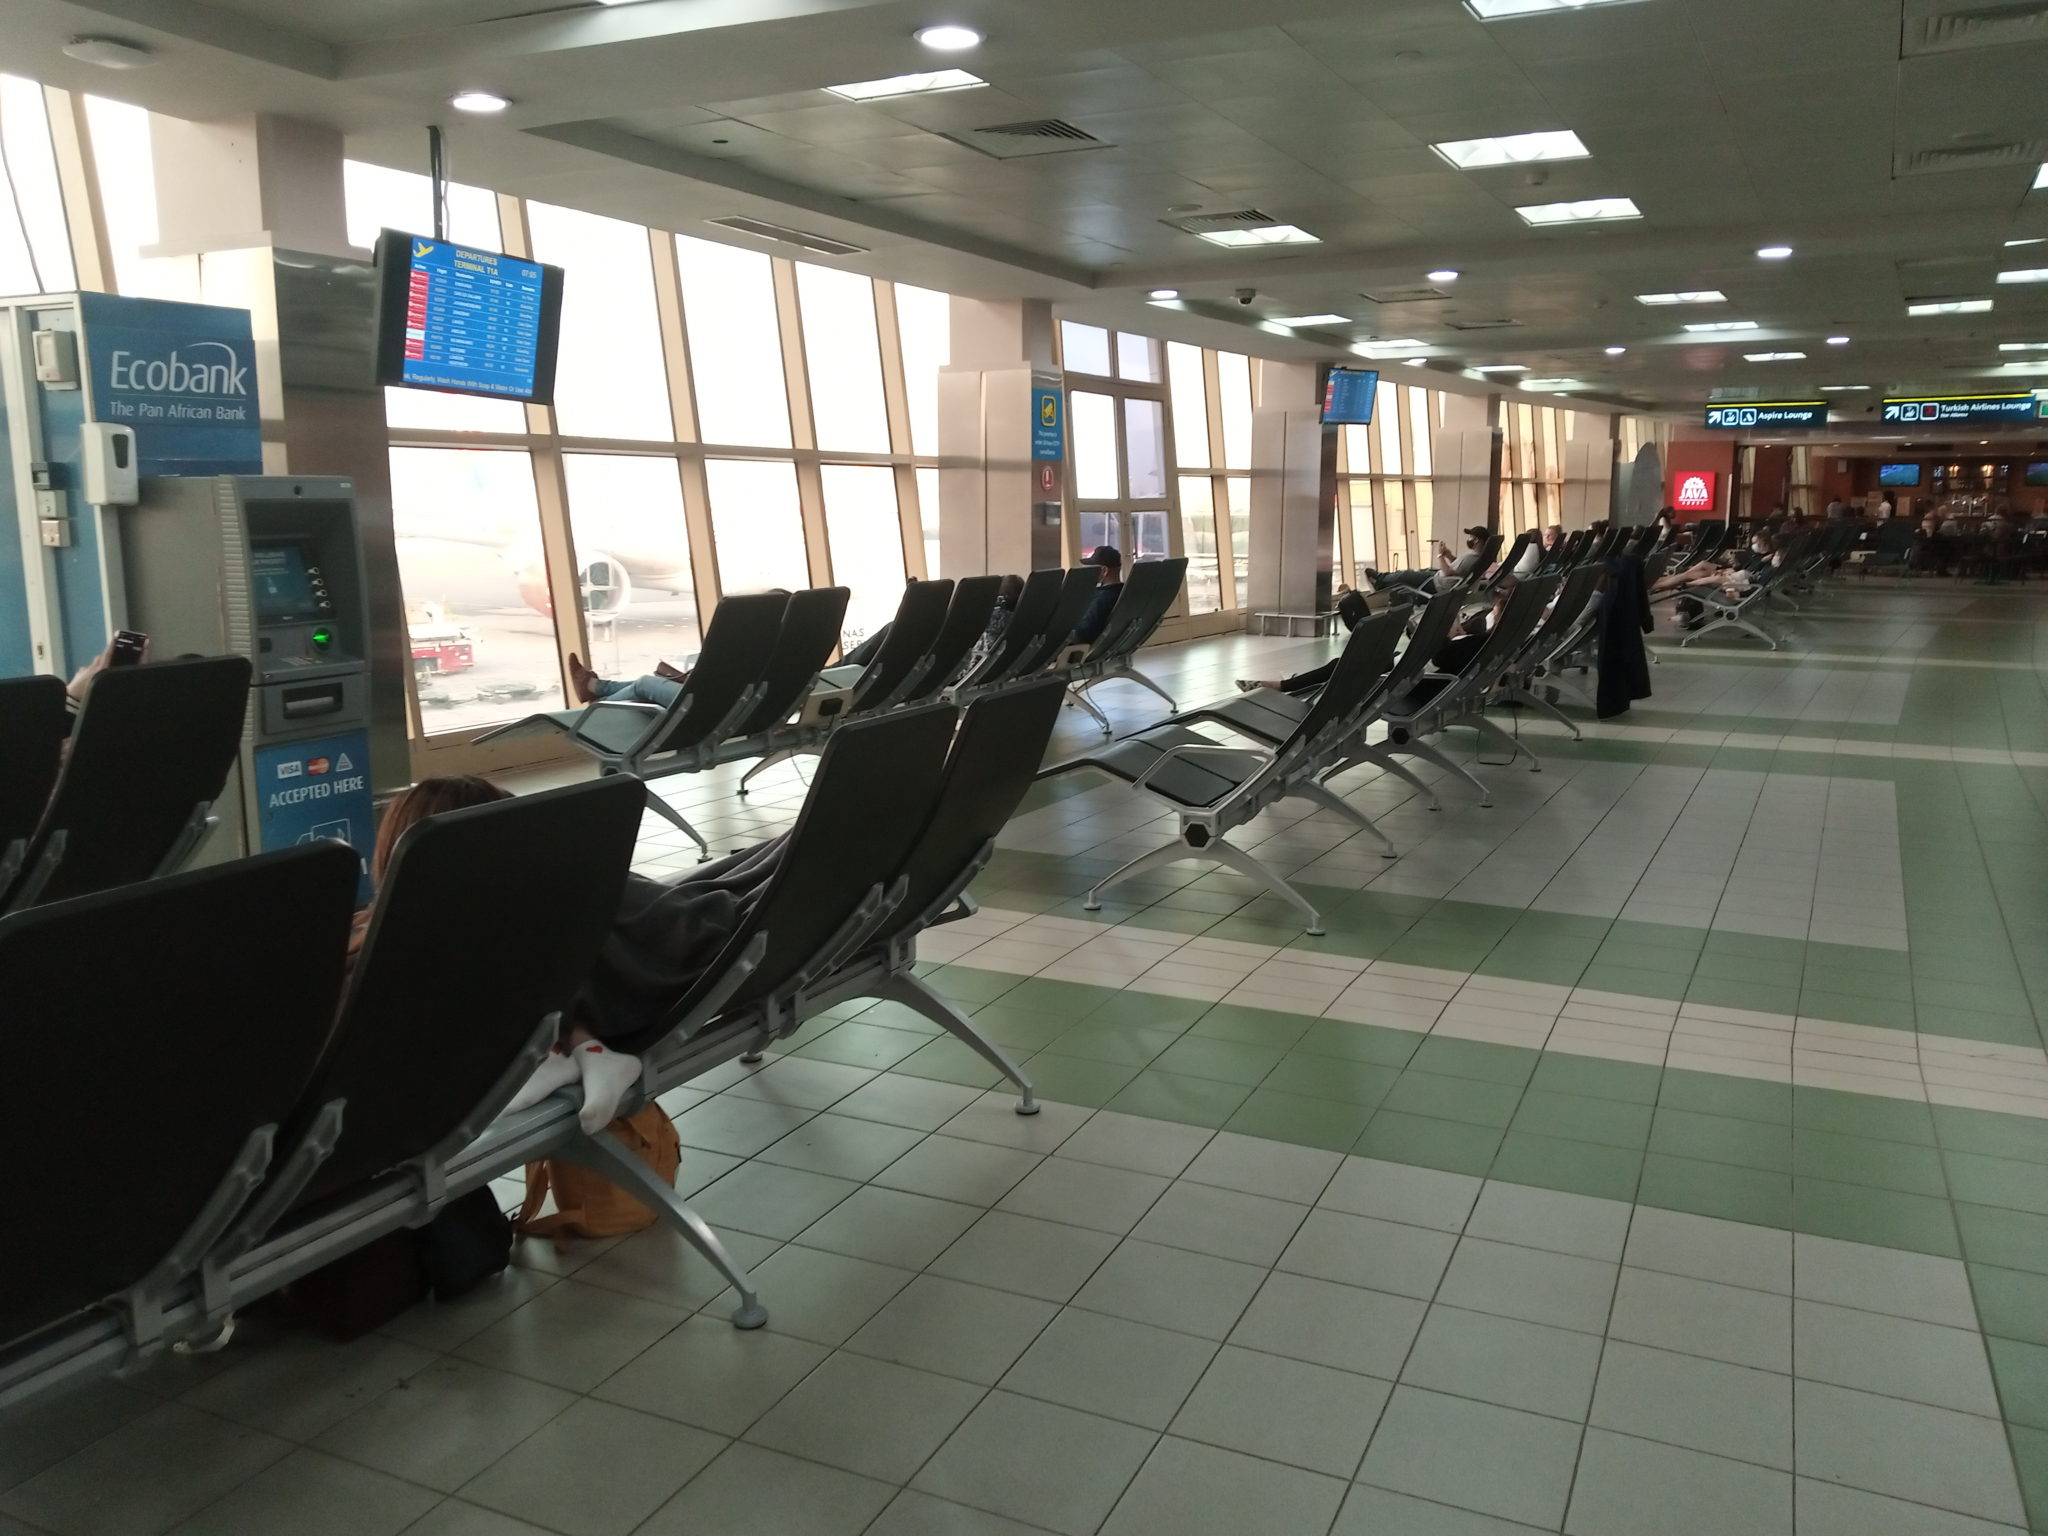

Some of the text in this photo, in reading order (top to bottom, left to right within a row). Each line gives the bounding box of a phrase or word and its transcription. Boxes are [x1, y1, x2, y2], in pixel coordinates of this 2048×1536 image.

[456, 250, 497, 265] DEPARTURES
[454, 260, 485, 272] TERMINAL
[111, 342, 248, 395] Ecobank
[110, 400, 246, 420] The Pan African Bank
[1941, 402, 2032, 412] Turkish Airlines Lounge
[1758, 411, 1813, 421] Aspire Lounge
[1678, 488, 1709, 499] JAVA
[281, 764, 300, 775] VISA
[269, 776, 364, 808] ACCEPTED HERE
